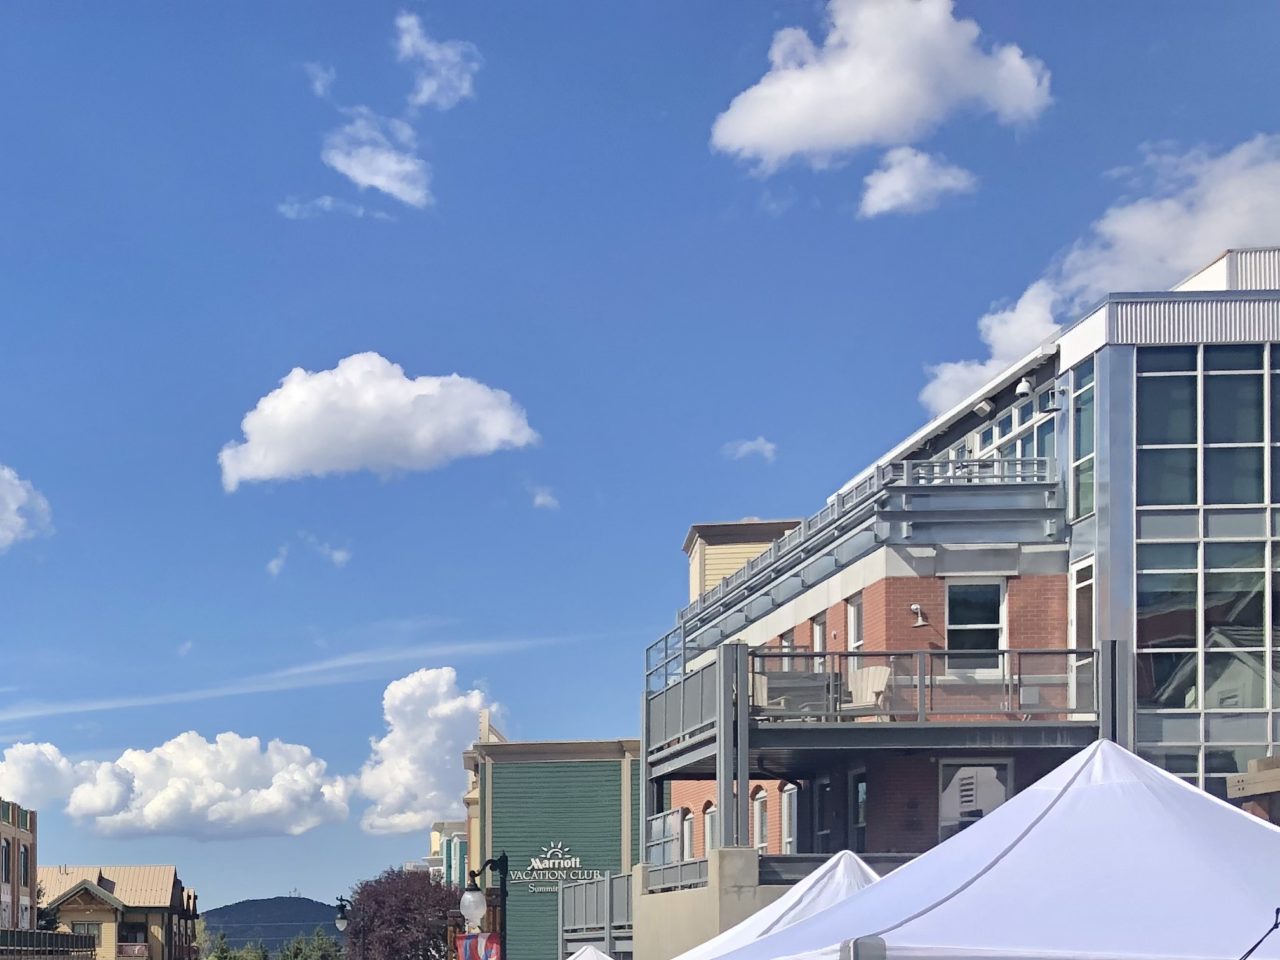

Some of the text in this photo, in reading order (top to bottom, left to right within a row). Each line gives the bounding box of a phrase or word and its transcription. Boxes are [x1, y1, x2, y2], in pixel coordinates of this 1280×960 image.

[527, 857, 582, 870] Marriott
[509, 870, 602, 880] VACATION CLUB
